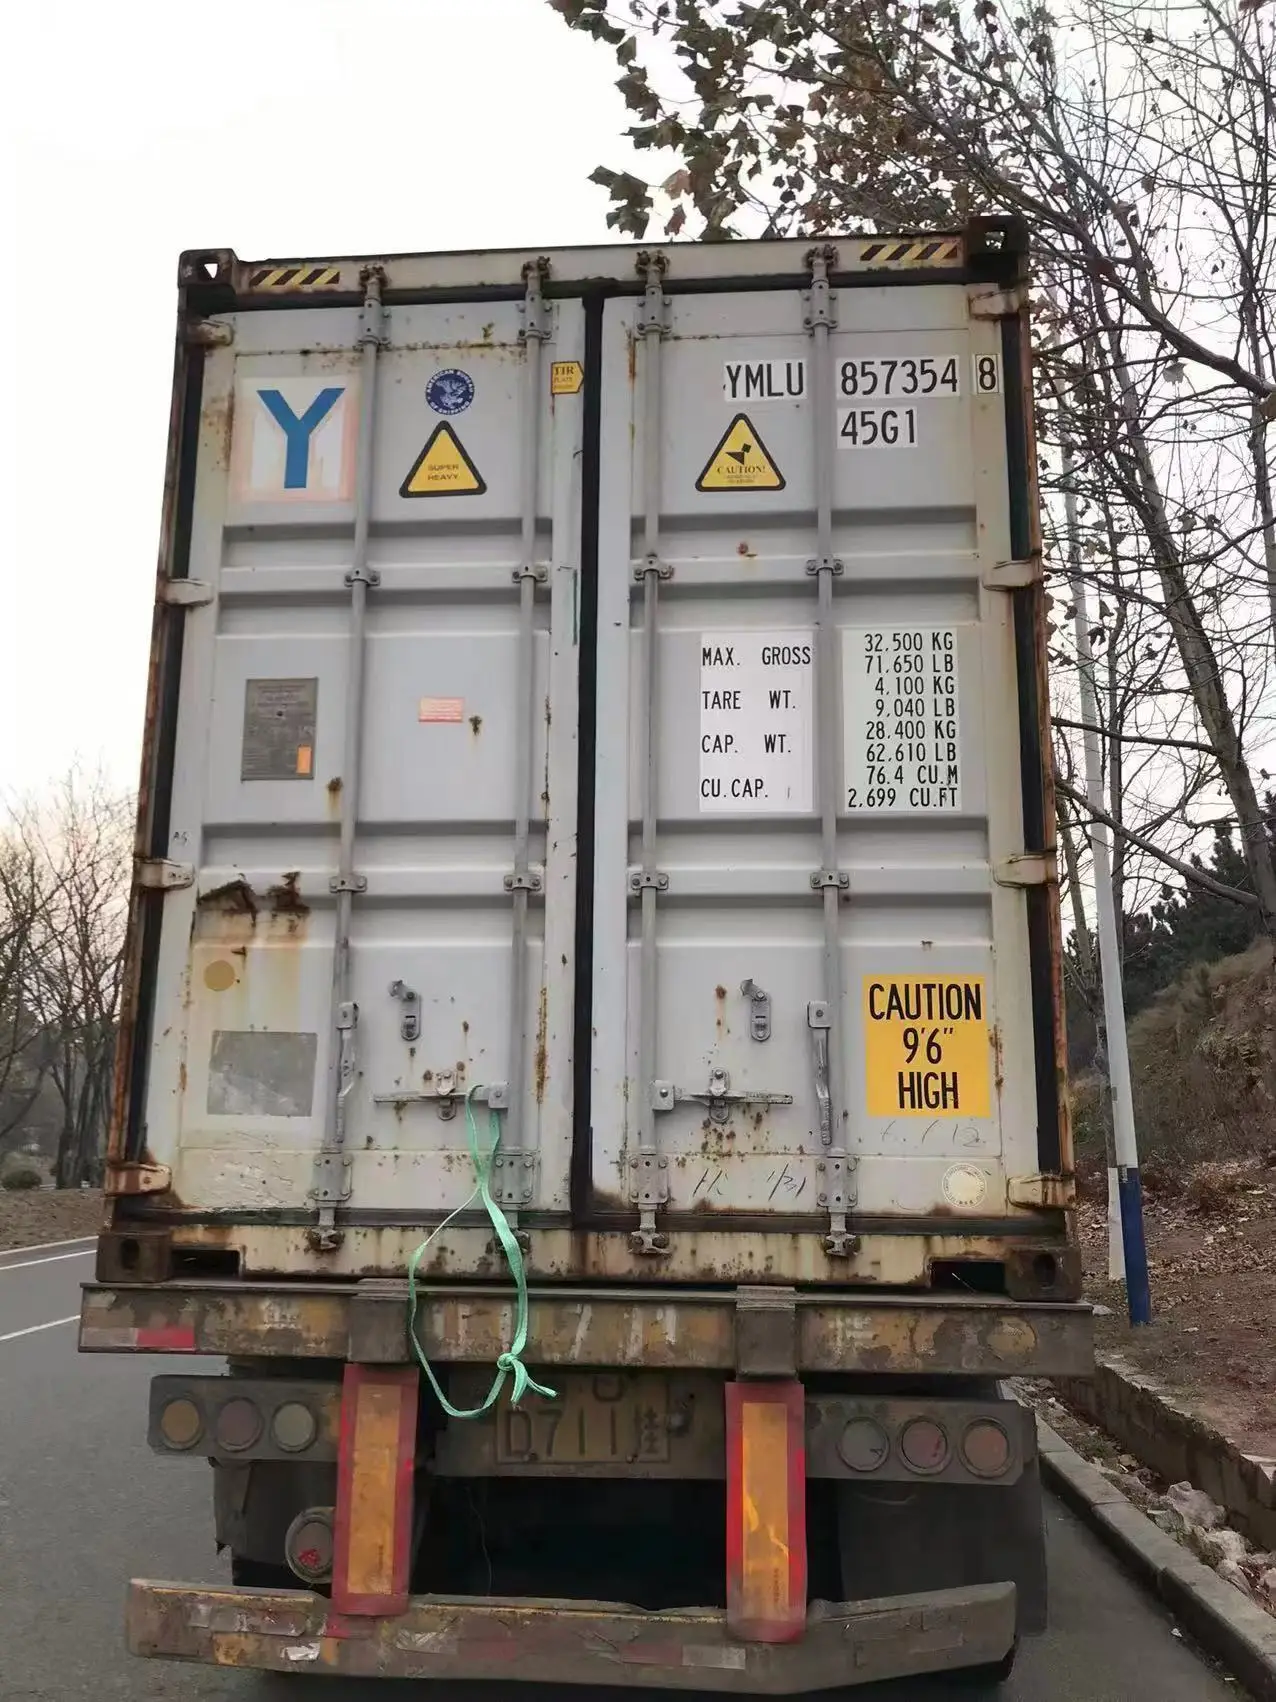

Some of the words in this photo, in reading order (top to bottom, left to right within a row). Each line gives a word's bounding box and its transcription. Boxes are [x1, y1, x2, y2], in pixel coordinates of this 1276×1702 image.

[553, 366, 574, 375] TIR
[726, 362, 804, 398] YMLU
[841, 359, 958, 395] 857354
[978, 356, 997, 391] 8
[841, 409, 915, 446] 45G1
[256, 387, 346, 489] Y
[717, 465, 766, 474] CAUTION!
[864, 633, 923, 652] 32,500
[932, 632, 953, 650] KG
[702, 647, 741, 666] MAX.
[762, 646, 811, 666] GROSS
[865, 655, 924, 674] 71,650
[932, 654, 954, 673] LB
[875, 677, 924, 696] 4,100
[933, 676, 955, 695] KG
[702, 690, 741, 709] TARE
[769, 690, 796, 709] WT.
[875, 699, 925, 718] 9,040
[934, 698, 955, 717] LB
[866, 720, 926, 740] 28,400
[934, 720, 956, 738] KG
[701, 735, 738, 753] CAP.
[764, 734, 791, 753] WT.
[866, 743, 926, 763] 62,610
[935, 742, 957, 761] LB
[867, 765, 904, 784] 76.4
[917, 764, 958, 784] CU.M
[701, 779, 768, 798] CU.CAP.
[848, 787, 896, 808] 2,699
[909, 787, 958, 807] CU.FT
[869, 983, 982, 1020] CAUTION
[898, 1071, 960, 1109] HIGH
